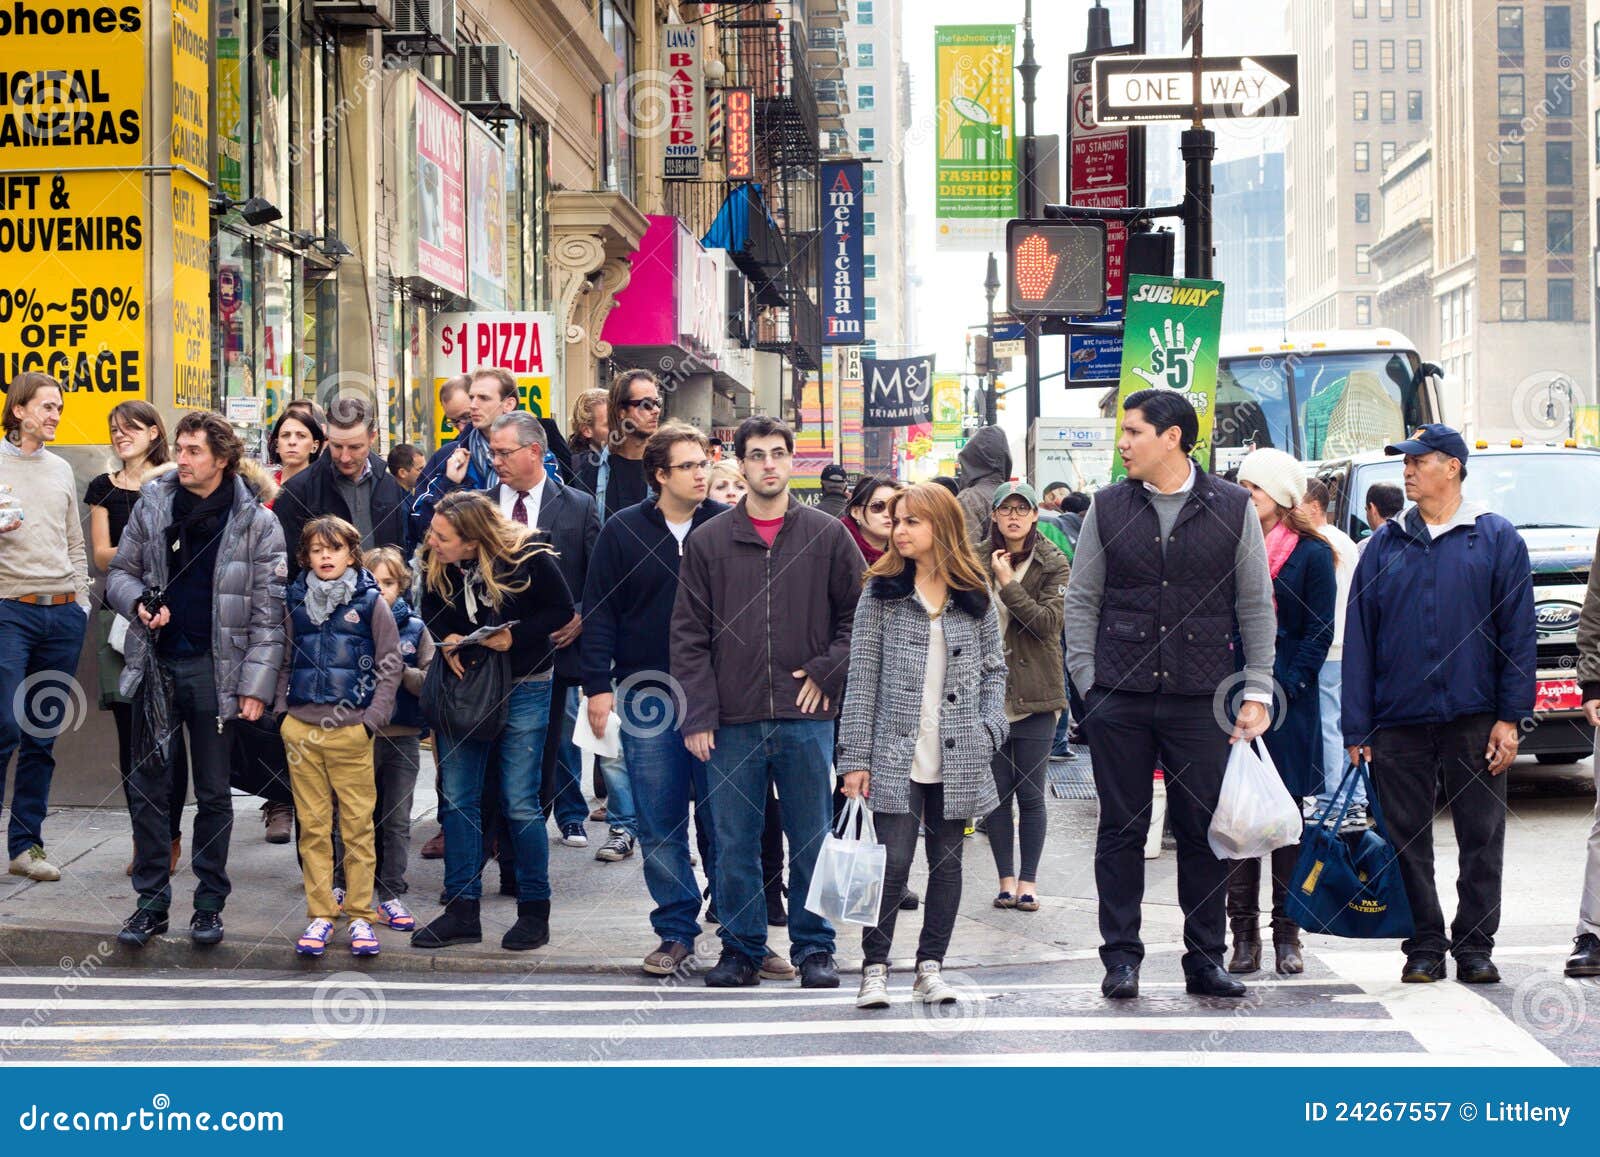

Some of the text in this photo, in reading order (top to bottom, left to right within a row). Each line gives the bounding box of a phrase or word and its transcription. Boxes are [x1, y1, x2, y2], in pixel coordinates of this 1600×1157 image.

[669, 53, 694, 144] BARBER
[1126, 76, 1267, 102] ONE WAY
[174, 82, 202, 128] DIGITAL
[666, 145, 697, 156] SHOP
[1075, 139, 1125, 154] NO STANDING
[939, 170, 1012, 182] FASHION
[50, 176, 70, 210] &
[939, 184, 1013, 196] DISTRICT
[828, 169, 855, 314] Americana
[1132, 284, 1219, 307] SUBWAY
[21, 324, 87, 347] OFF
[827, 316, 860, 337] Inn
[187, 338, 201, 362] OFF
[477, 323, 543, 373] PIZZA
[1151, 347, 1188, 389] $5
[870, 360, 931, 404] M&J
[869, 405, 930, 418] TRIMMING
[1537, 607, 1571, 622] Ford
[1537, 684, 1574, 696] Apple
[1349, 902, 1387, 913] CATERING
